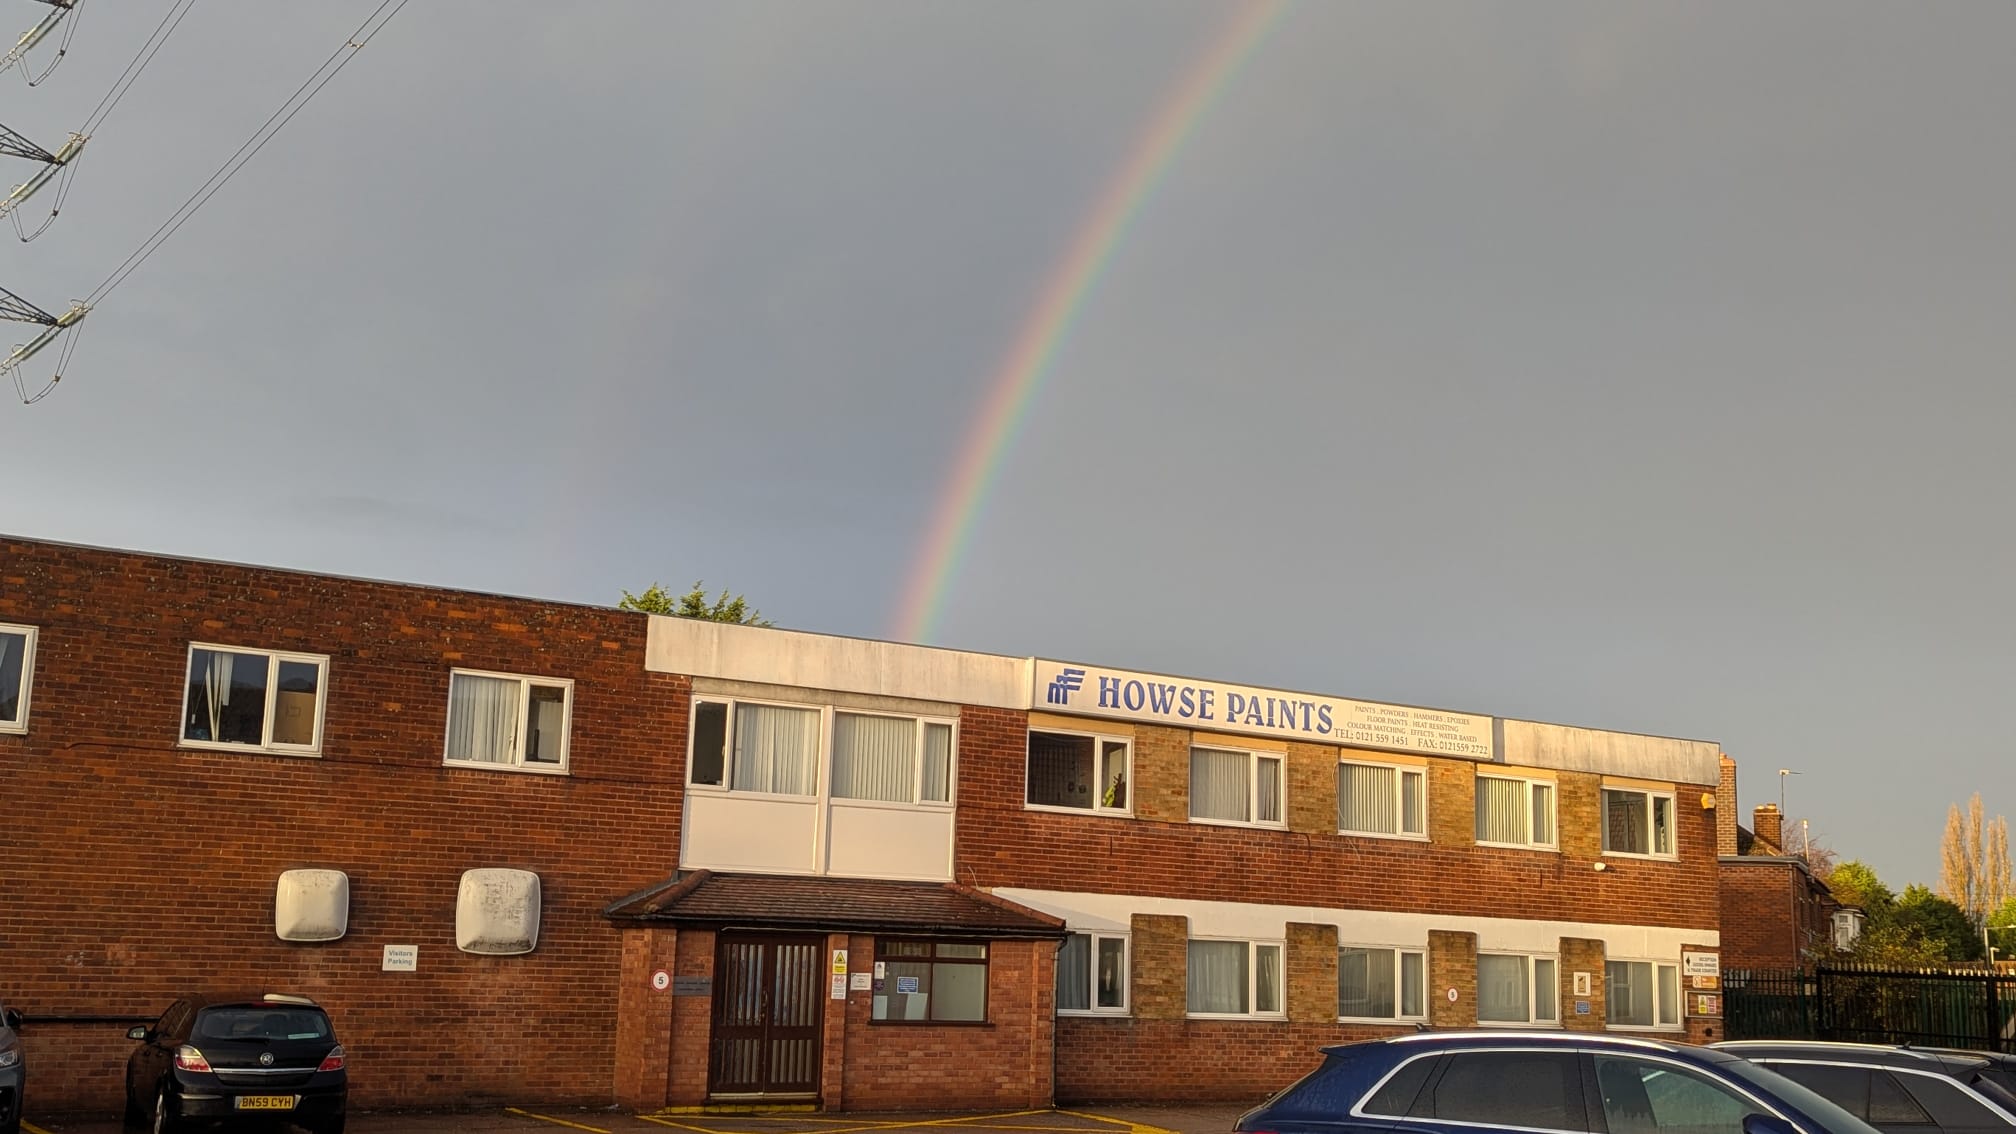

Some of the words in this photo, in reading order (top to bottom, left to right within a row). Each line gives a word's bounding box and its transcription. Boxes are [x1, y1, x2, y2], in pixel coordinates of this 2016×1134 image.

[1098, 676, 1215, 720] HOWSE
[1226, 692, 1333, 734] PAINTS
[1355, 705, 1376, 714] PAINTS
[1380, 708, 1409, 718] POWDERS
[1414, 712, 1443, 722] HAMMERS
[1447, 716, 1470, 725] EPOXIES
[1366, 715, 1386, 723] FLOOR
[1387, 718, 1408, 726] PAINTS
[1413, 720, 1428, 728] HEAT
[1429, 722, 1459, 732] RESISTING
[1334, 727, 1354, 740] TEL:
[1355, 731, 1373, 742] 0121
[1375, 733, 1389, 743] 559
[1392, 735, 1408, 745] 1451
[1418, 738, 1438, 749] FAX:
[1471, 744, 1488, 755] 2722
[1347, 721, 1372, 731] COLOUR
[1373, 725, 1406, 735] MATCHING
[1410, 729, 1434, 738] EFFECTS
[1438, 732, 1458, 740] WATER
[1459, 734, 1477, 743] BASED
[387, 958, 413, 966] Parking
[658, 976, 664, 985] 5
[242, 1097, 269, 1107] BN59
[271, 1097, 291, 1107] CYH
